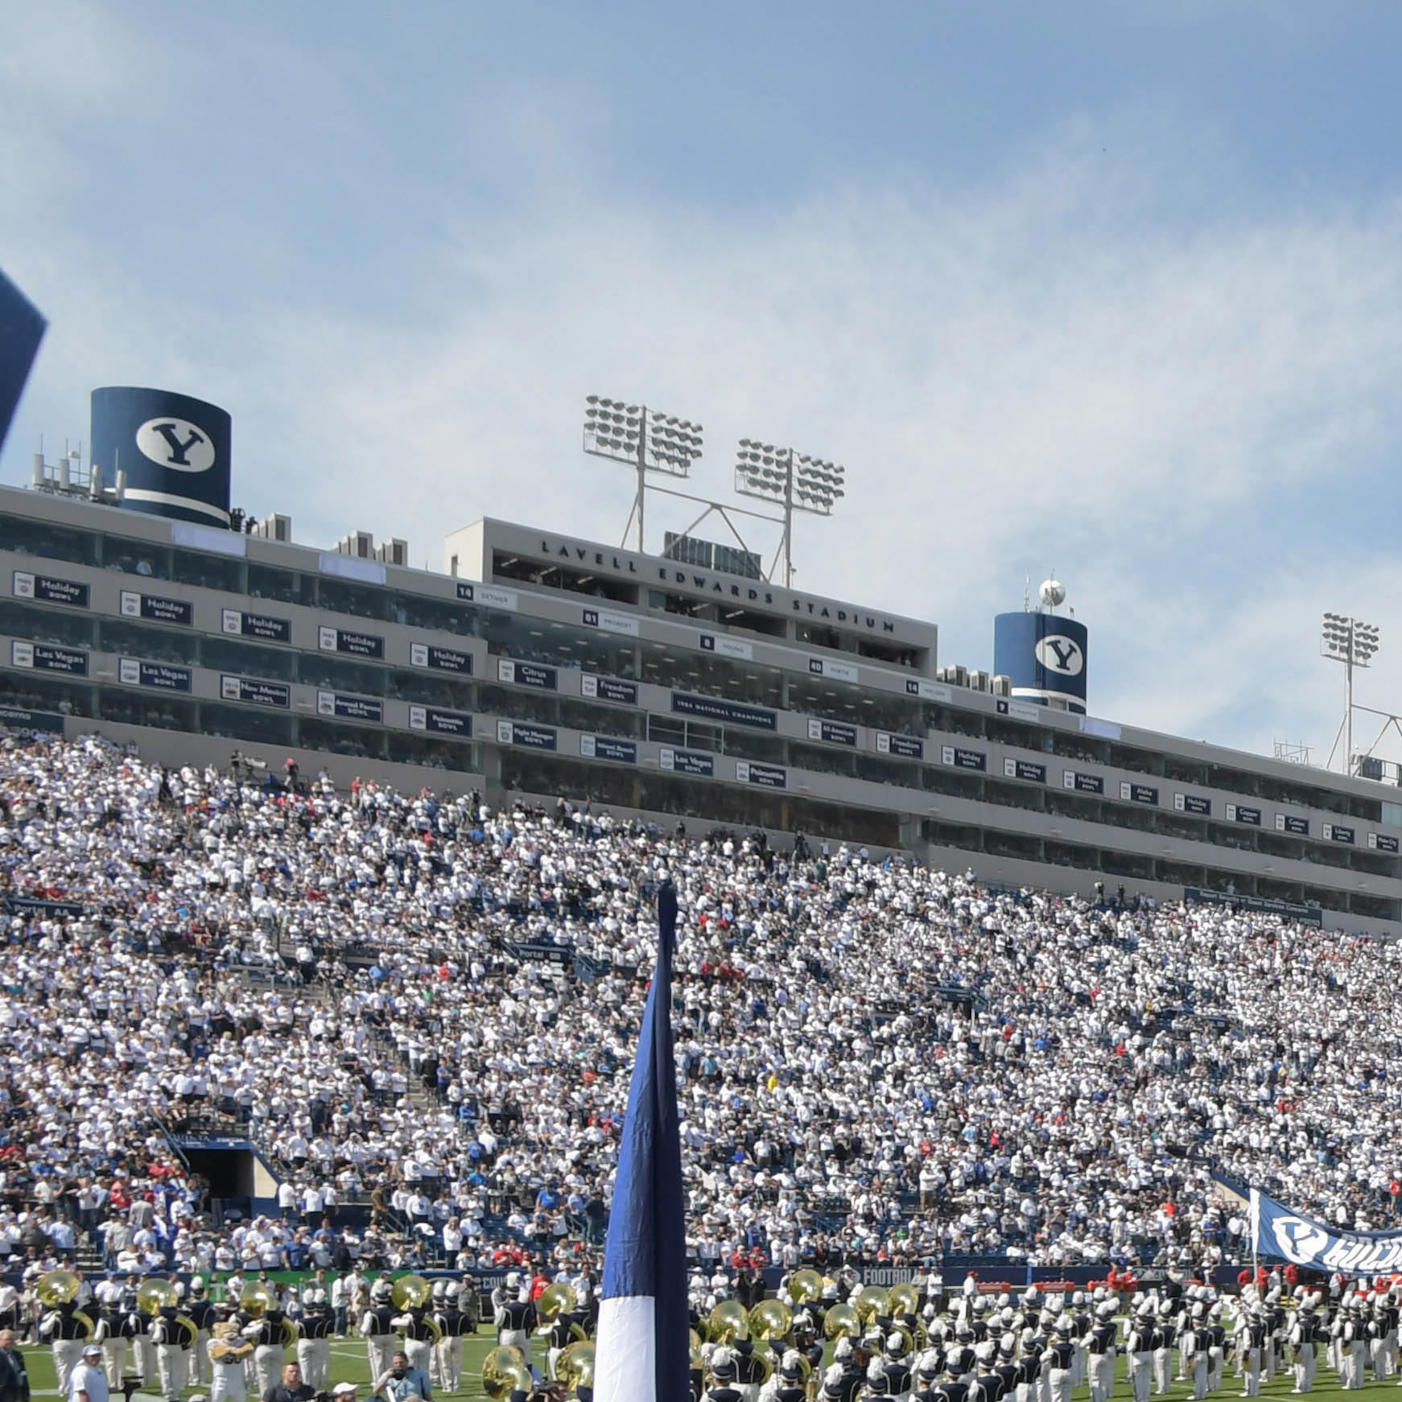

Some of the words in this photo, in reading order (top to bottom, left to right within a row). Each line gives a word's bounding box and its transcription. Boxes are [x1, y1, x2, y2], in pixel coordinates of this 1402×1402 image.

[41, 580, 80, 596] Holiday
[542, 541, 636, 573] LAVELL
[659, 568, 773, 604] EDWARDS
[793, 600, 893, 633] STADIUM
[147, 599, 185, 614] Holiday
[248, 617, 283, 631] Holiday
[343, 634, 375, 648] Holiday
[35, 648, 53, 660] Las
[56, 650, 84, 665] Vegas
[434, 650, 465, 664] Holiday
[142, 665, 158, 677] Las
[161, 668, 188, 681] Vegas
